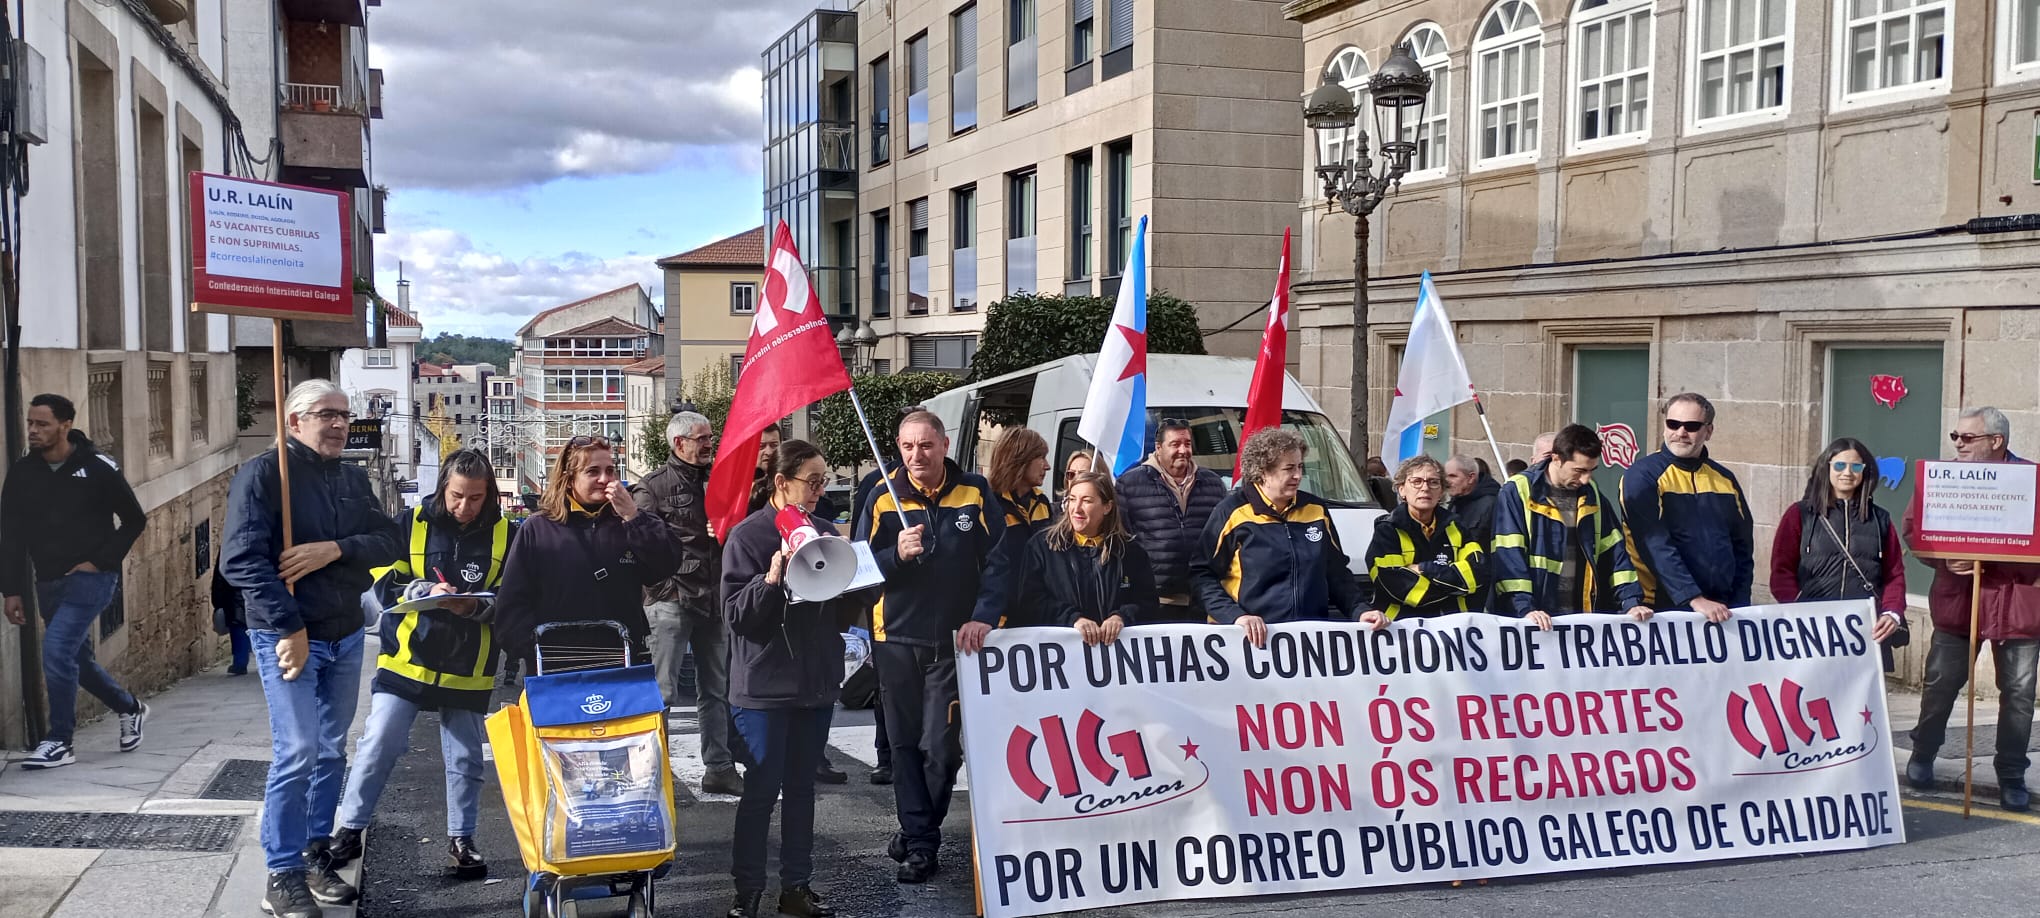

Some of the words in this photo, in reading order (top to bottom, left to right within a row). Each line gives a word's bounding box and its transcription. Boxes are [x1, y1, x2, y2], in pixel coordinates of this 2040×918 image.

[208, 187, 242, 204] U.R.
[248, 192, 293, 210] LALÍN
[209, 219, 221, 229] AS
[224, 221, 274, 234] VACANTES
[276, 227, 320, 240] CUBRILAS
[210, 235, 216, 243] E
[218, 236, 240, 246] NON
[243, 238, 303, 252] SUPRIMILAS.
[210, 251, 304, 268] #correoslalinenloita
[208, 280, 265, 294] Confederación
[266, 286, 313, 298] Intersindical
[314, 290, 340, 302] Galega
[350, 434, 369, 444] CAFÉ
[1928, 469, 1955, 479] U.R.
[1960, 468, 1997, 481] LALÍN
[1927, 491, 1959, 499] SERVIZO
[1961, 492, 1989, 500] POSTAL
[1921, 534, 1966, 543] Confederación
[1967, 536, 2006, 545] Intersindical
[2007, 537, 2030, 547] Galega
[978, 642, 1069, 695] POR
[1083, 633, 1230, 688] UNHAS
[1243, 618, 1488, 681] CONDICIÓNS
[1500, 624, 1545, 671] DE
[1553, 621, 1728, 669] TRABALLO
[1740, 613, 1866, 662] DIGNAS
[1235, 700, 1344, 752] NON
[1369, 684, 1435, 745] ÓS
[1456, 687, 1683, 741] RECORTES
[1726, 677, 1840, 759] CIG
[1006, 708, 1152, 804] CIG
[1784, 741, 1866, 770] Correos
[1243, 763, 1352, 817] NON
[1371, 747, 1439, 809] ÓS
[1453, 746, 1696, 804] RECARGOS
[1074, 778, 1185, 814] Correos
[994, 847, 1085, 906] POR
[1100, 839, 1159, 893] UN
[1175, 828, 1346, 886] CORREO
[1360, 809, 1528, 876] PÚBLICO
[1538, 805, 1677, 862] GALEGO
[1688, 803, 1729, 850] DE
[1740, 791, 1893, 846] CALIDADE
